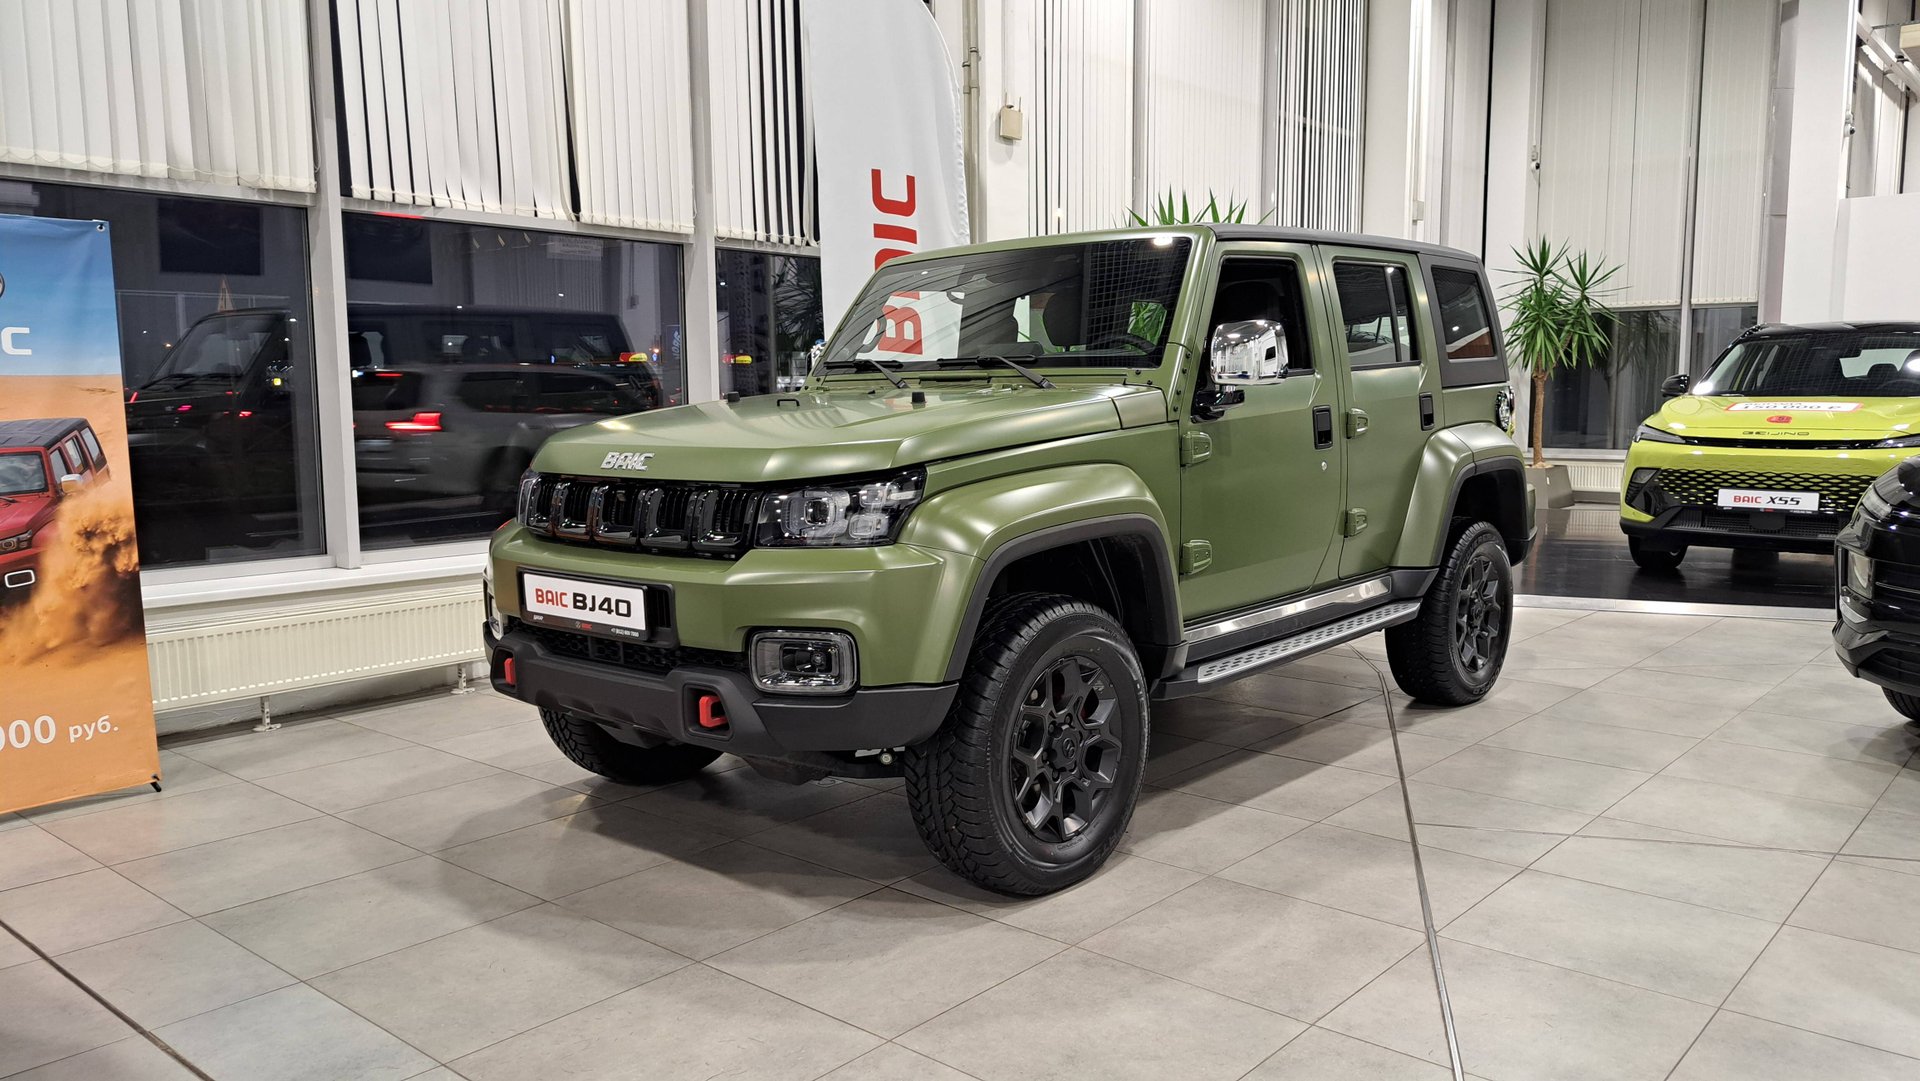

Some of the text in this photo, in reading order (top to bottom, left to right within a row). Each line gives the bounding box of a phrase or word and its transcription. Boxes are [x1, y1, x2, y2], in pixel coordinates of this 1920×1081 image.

[600, 451, 655, 471] BAIC
[1733, 495, 1802, 506] BAIC X55
[535, 588, 632, 618] BAIC BJ40
[0, 714, 119, 752] 00 руб.
